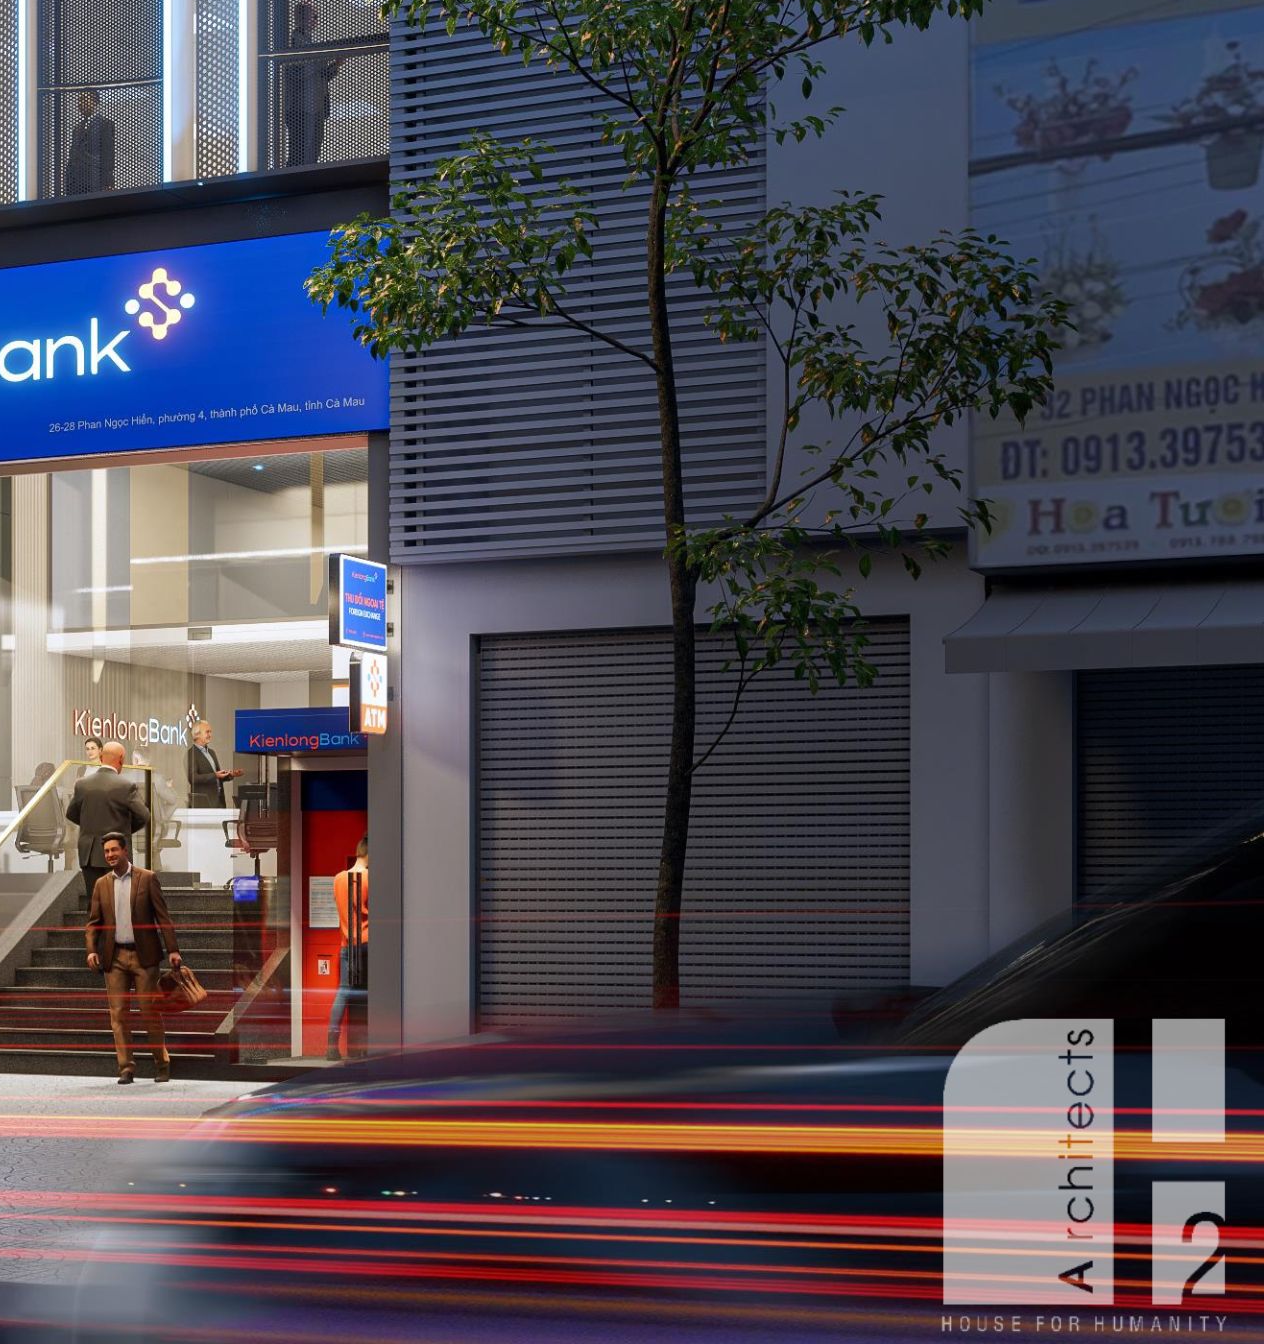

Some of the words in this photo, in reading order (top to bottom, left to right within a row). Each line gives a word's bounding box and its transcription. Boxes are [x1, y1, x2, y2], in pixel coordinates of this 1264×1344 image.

[1080, 381, 1156, 417] PHAN
[1165, 374, 1240, 414] NGỌC
[49, 421, 75, 433] 26-28
[78, 420, 102, 430] Phan
[104, 417, 129, 430] Ngọc
[198, 410, 207, 421] 4,
[210, 407, 237, 419] thành
[277, 403, 302, 413] Mau,
[343, 397, 365, 408] Mau
[1001, 439, 1048, 481] ĐT:
[73, 709, 188, 747] KienlongBank
[364, 708, 386, 729] ATM
[249, 733, 360, 750] KienlongBank
